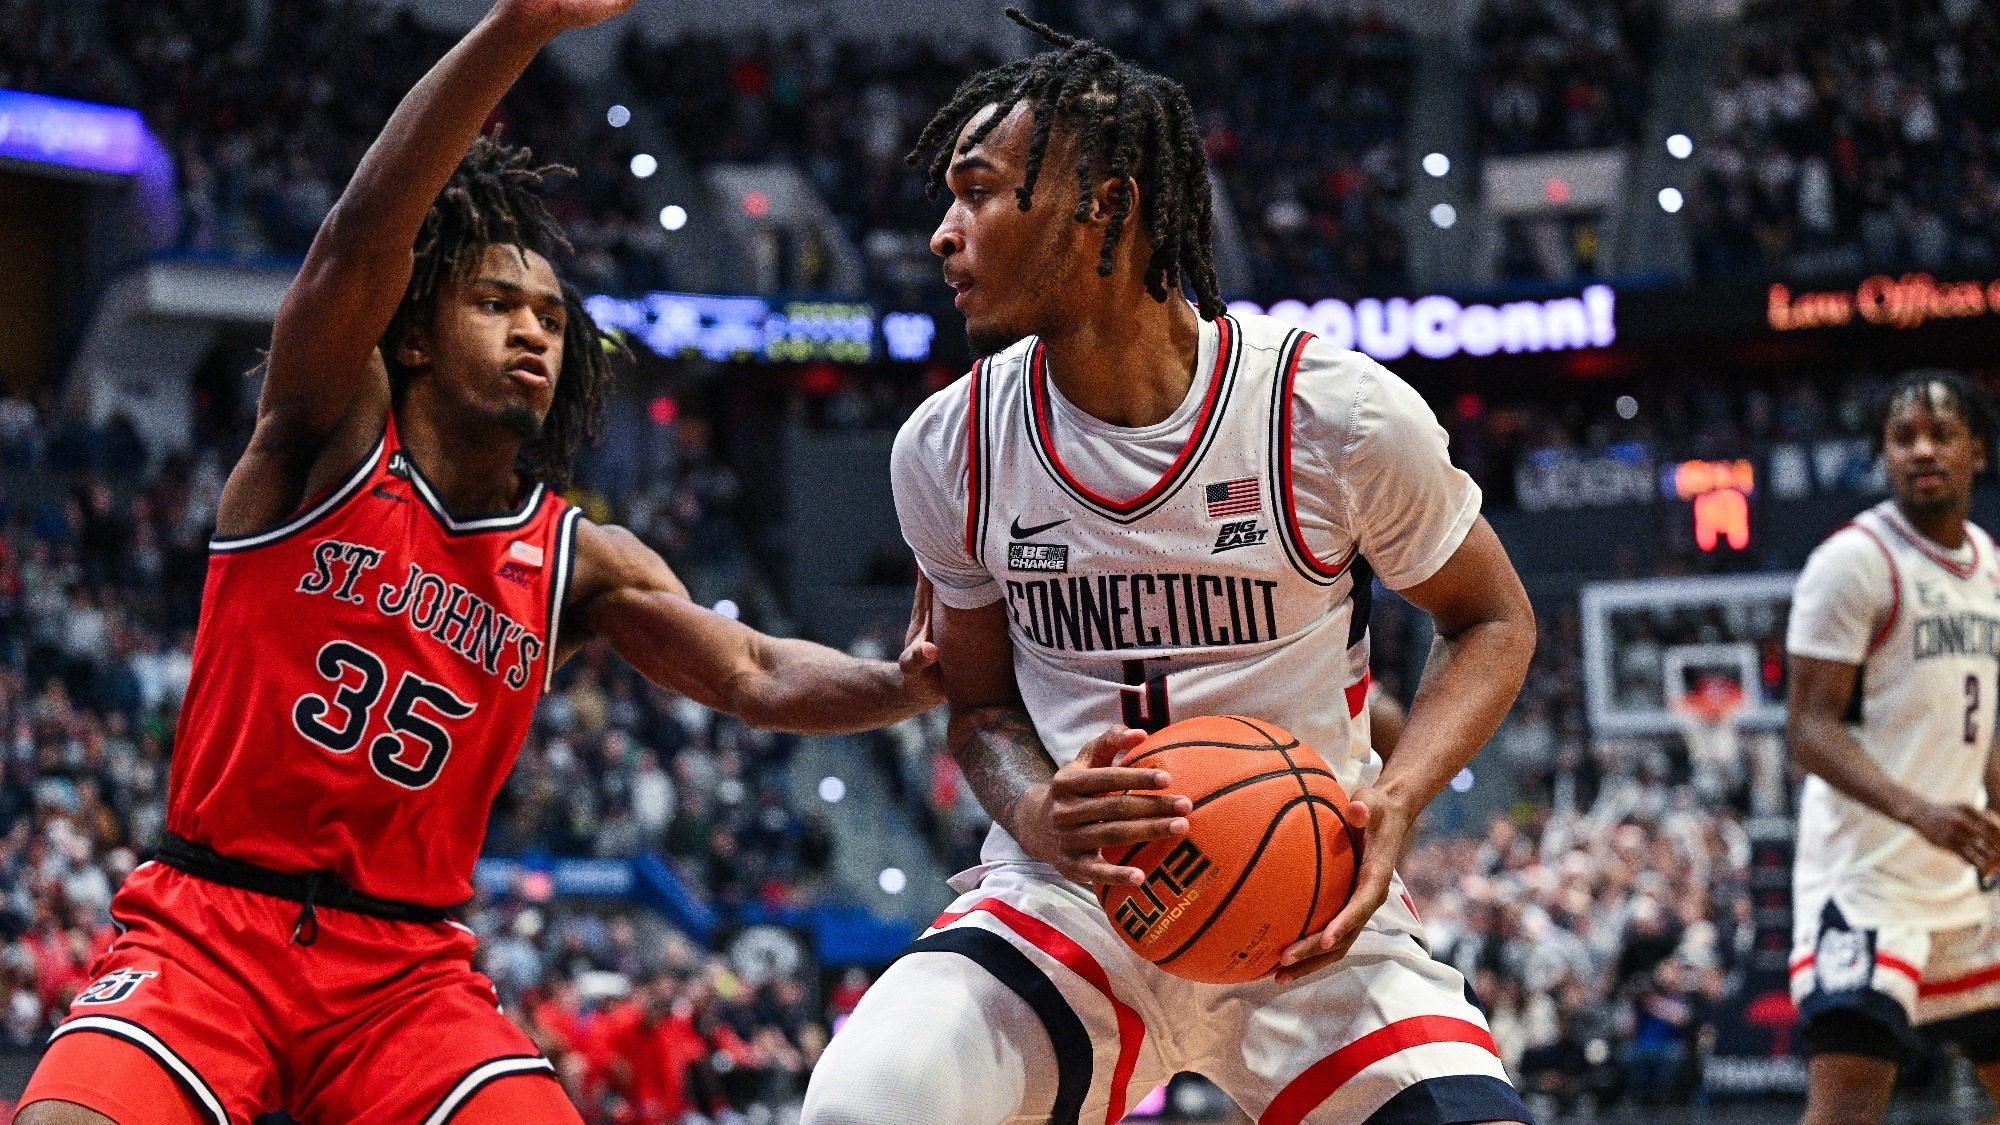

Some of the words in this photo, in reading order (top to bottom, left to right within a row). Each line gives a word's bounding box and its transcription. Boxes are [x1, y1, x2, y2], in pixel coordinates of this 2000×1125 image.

[1010, 558, 1066, 570] CHANGE
[1215, 529, 1269, 547] EAST
[1219, 519, 1258, 536] BIG
[296, 540, 386, 605] ST.
[377, 562, 543, 691] JOHN'S
[1006, 572, 1278, 651] CONNECTICUT
[292, 640, 479, 791] 35
[1963, 672, 1981, 745] 2
[1113, 836, 1213, 944] ELITE
